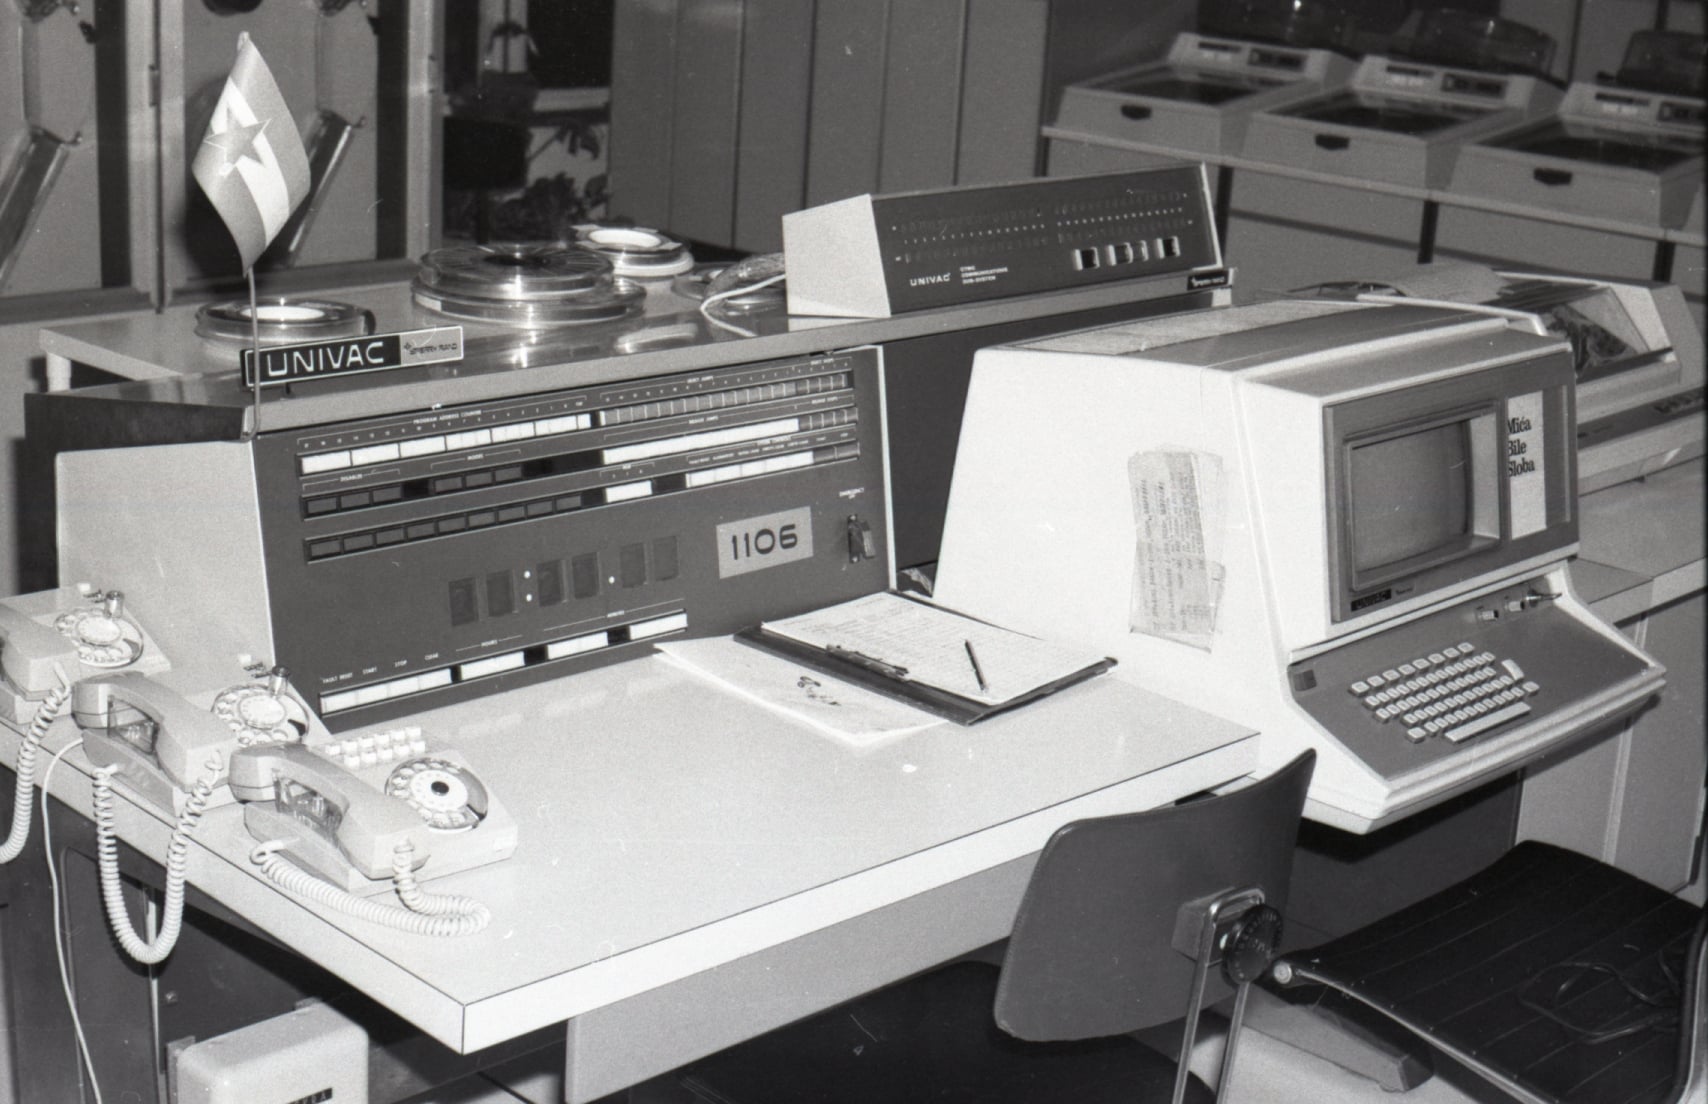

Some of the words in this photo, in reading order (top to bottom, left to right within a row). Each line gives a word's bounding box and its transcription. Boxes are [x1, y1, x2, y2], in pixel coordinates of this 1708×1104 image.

[910, 273, 951, 287] UNIVAC
[266, 341, 385, 378] UNIVAC
[1508, 457, 1535, 477] Sloba
[731, 523, 798, 561] 1106
